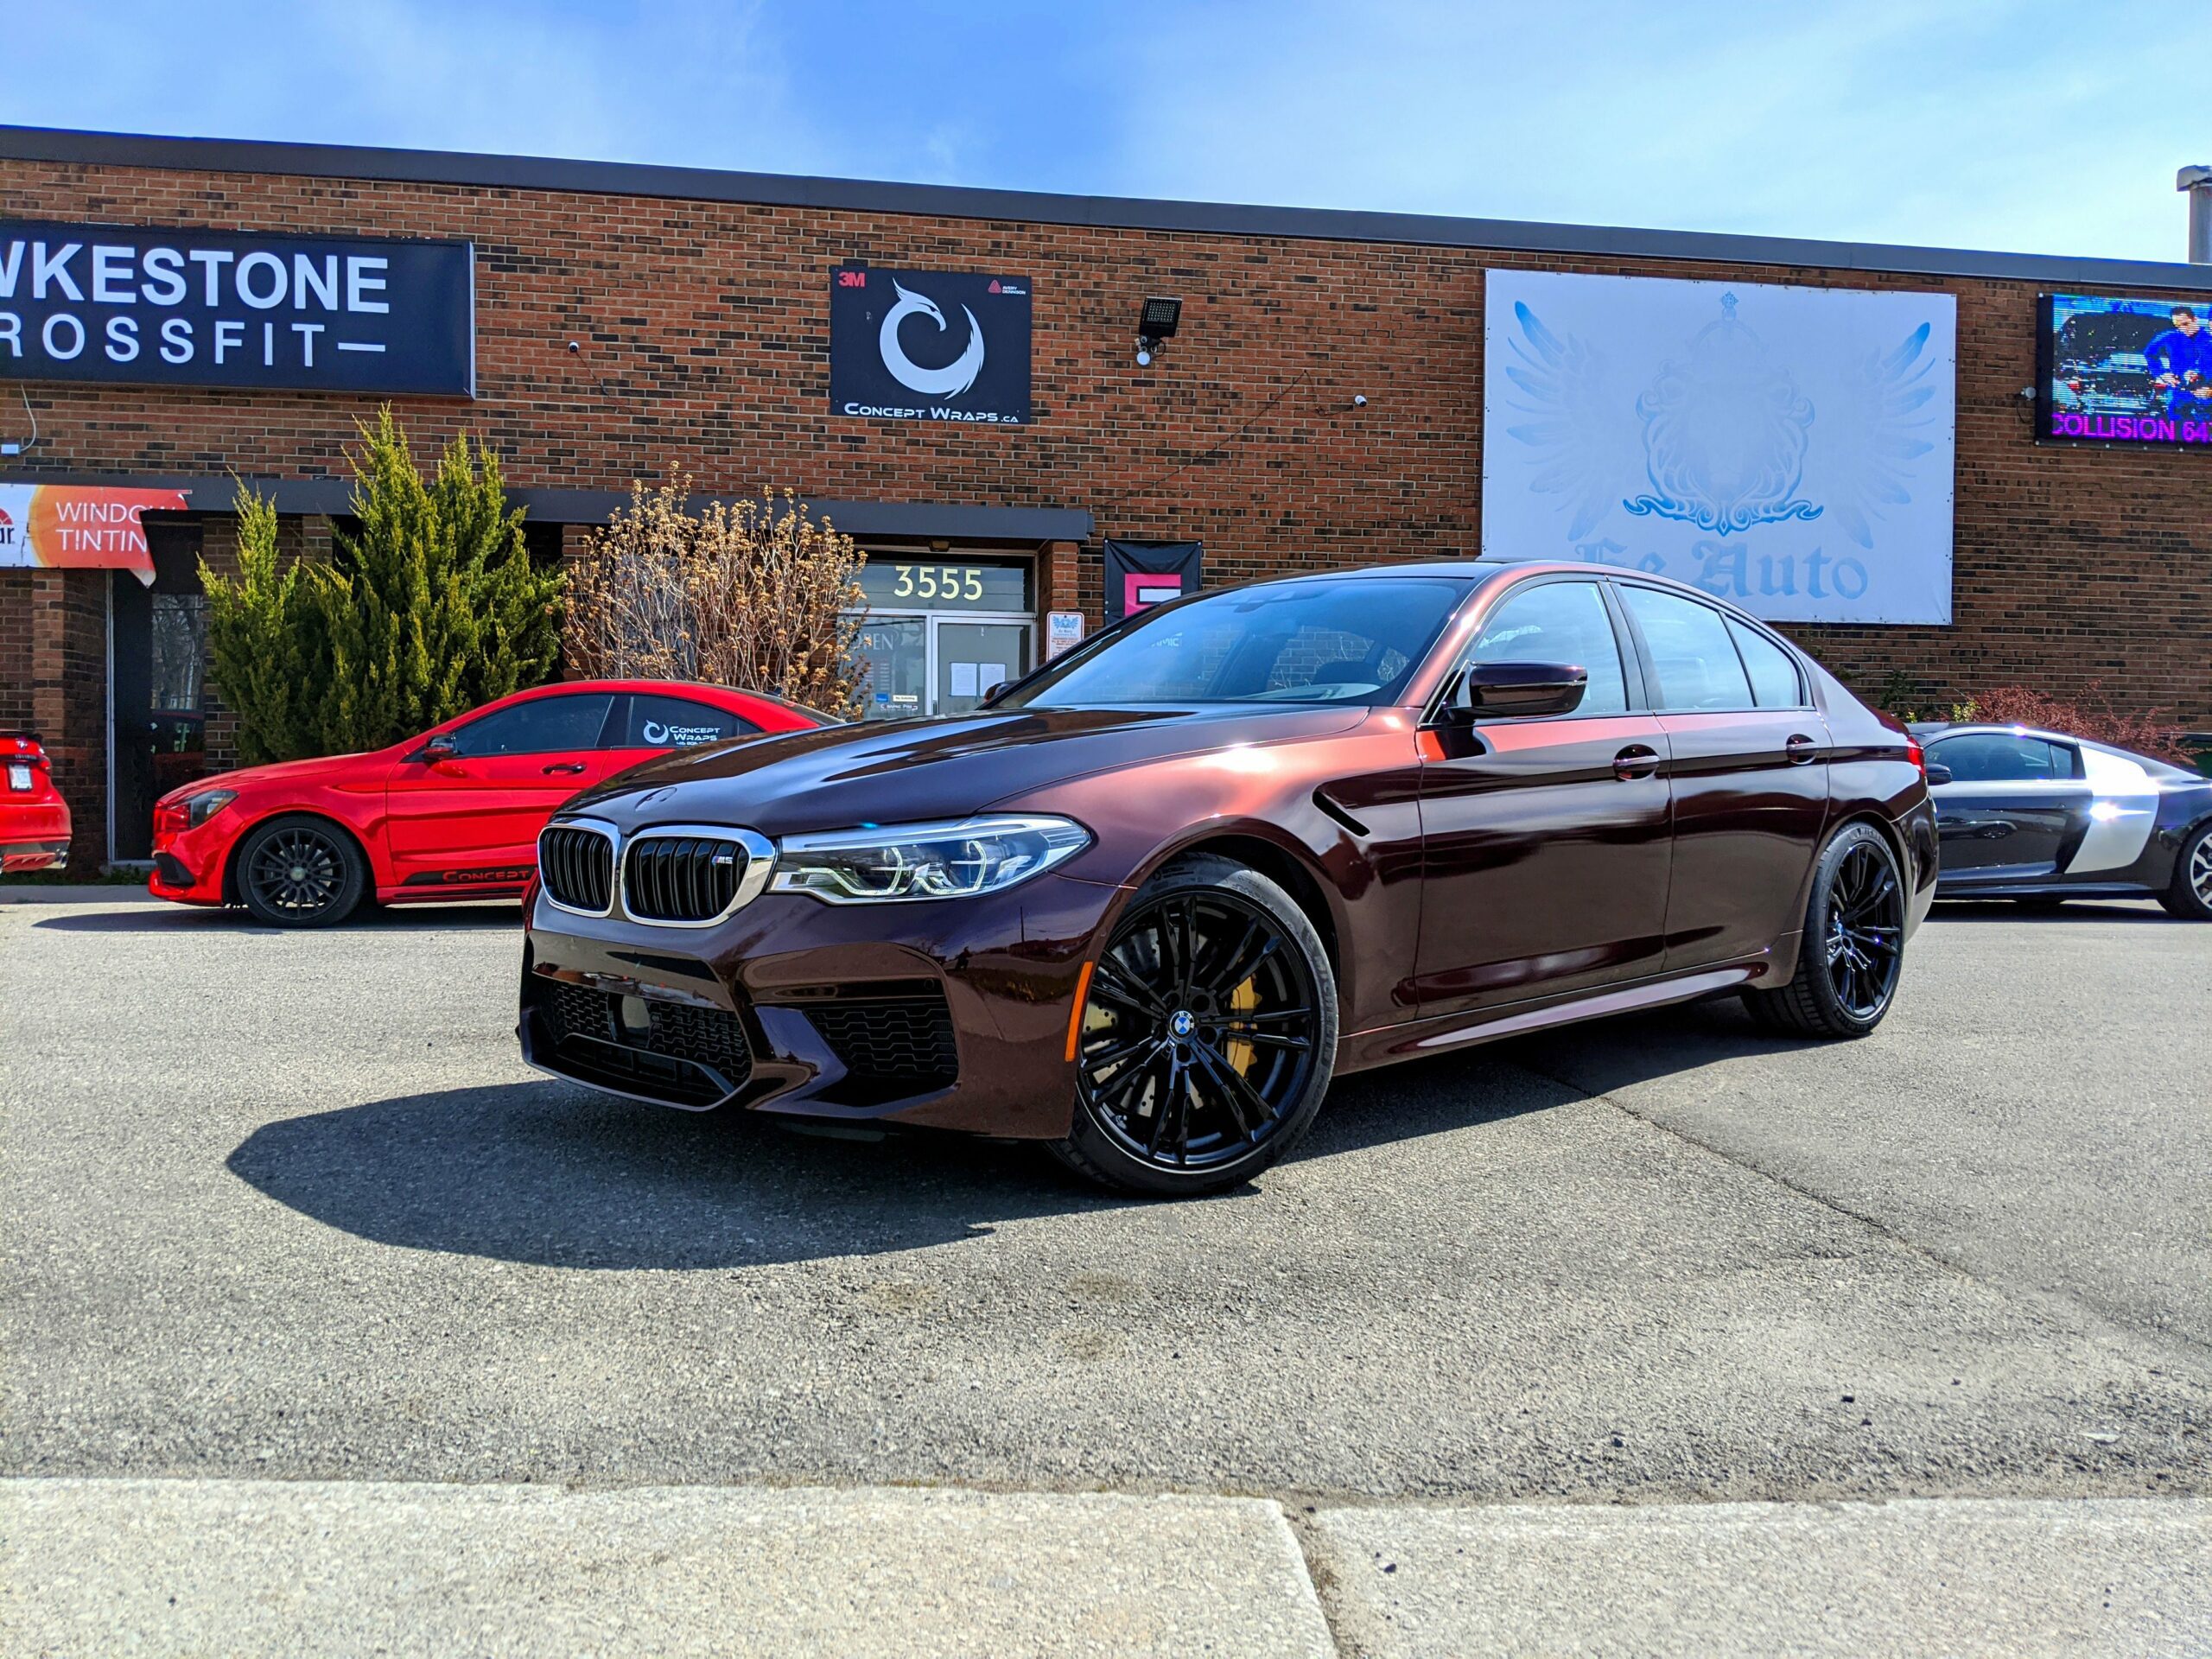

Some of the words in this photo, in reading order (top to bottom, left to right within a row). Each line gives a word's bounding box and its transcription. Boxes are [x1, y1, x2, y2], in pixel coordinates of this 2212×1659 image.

[838, 271, 865, 287] 3M
[2183, 421, 2212, 442] 64
[55, 502, 175, 524] WINDO
[1691, 539, 1869, 600] Auto
[893, 566, 982, 601] 3555
